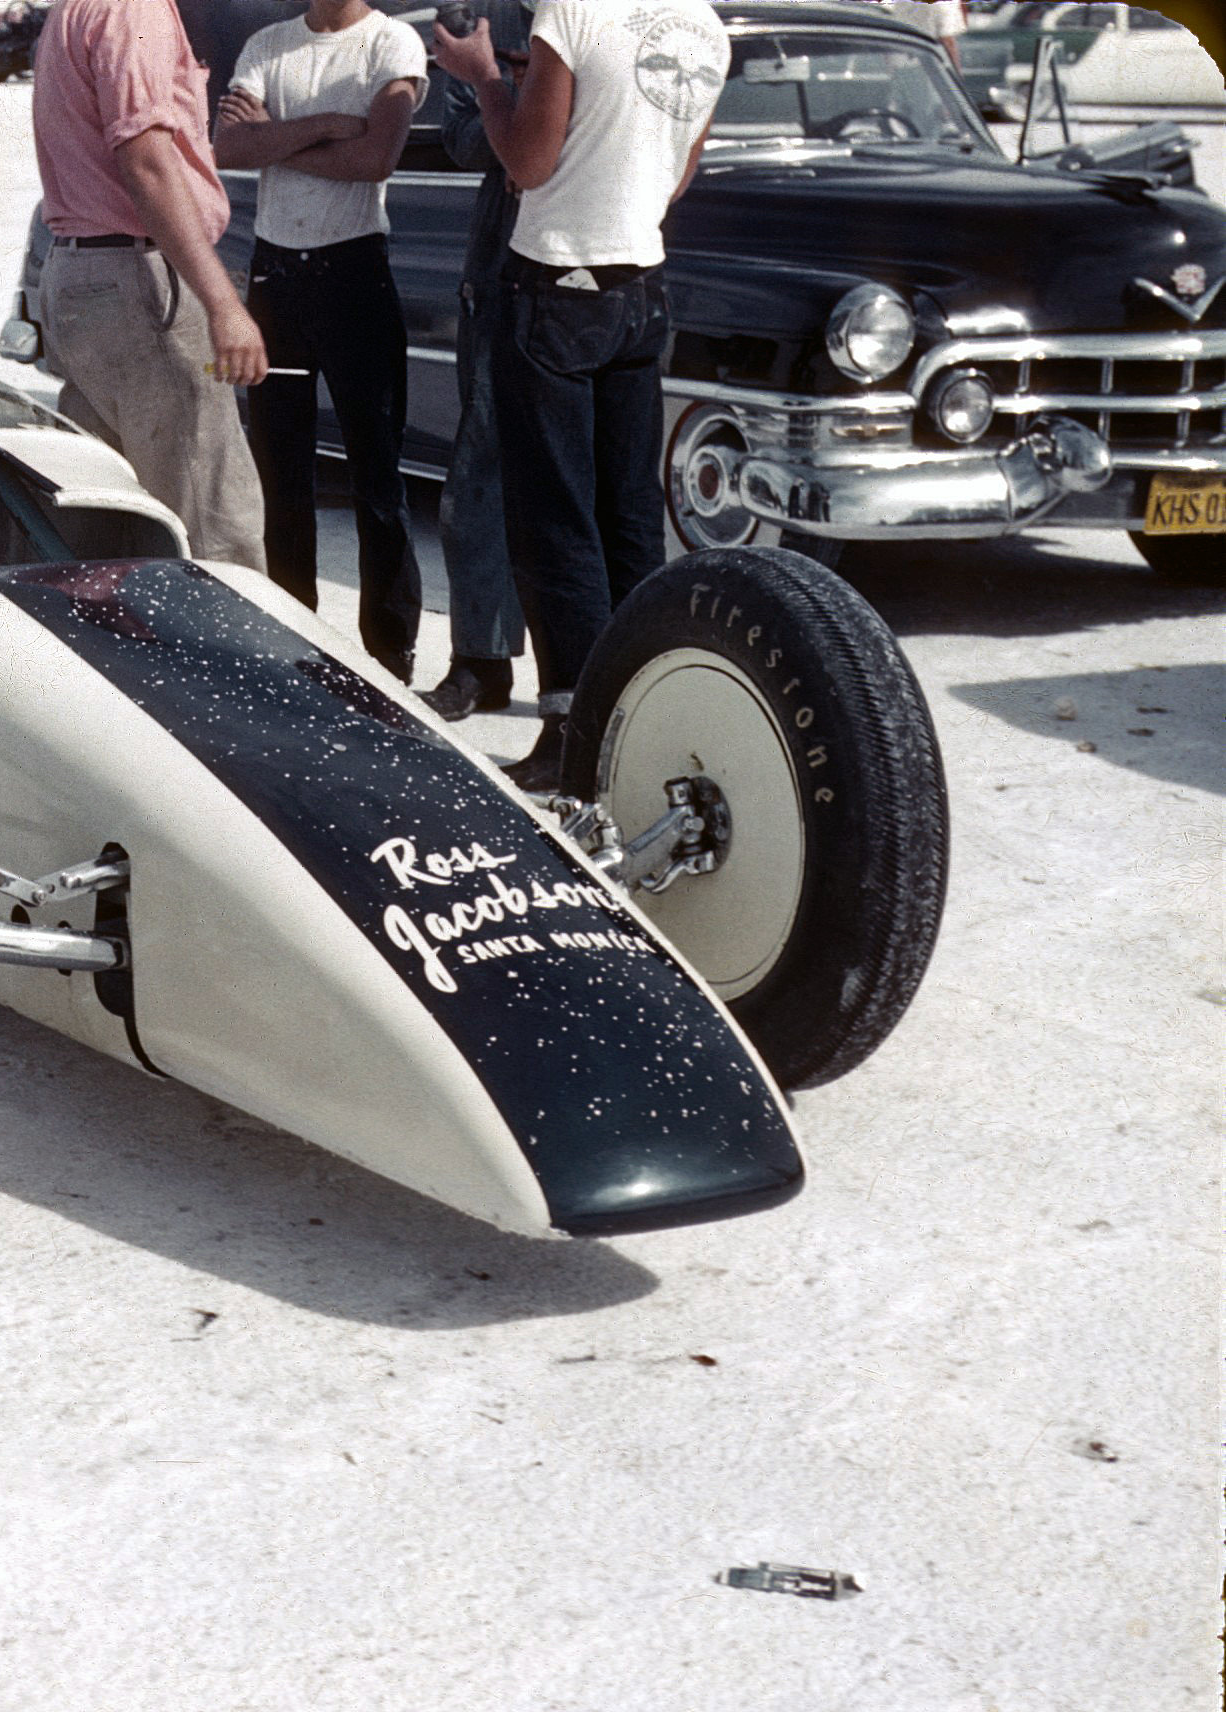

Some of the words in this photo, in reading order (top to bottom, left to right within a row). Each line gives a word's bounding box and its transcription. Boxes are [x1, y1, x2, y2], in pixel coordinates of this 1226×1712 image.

[1152, 491, 1200, 526] KHS
[690, 583, 834, 803] Firestone
[370, 837, 517, 889] Ross
[457, 935, 546, 964] SANTA
[550, 930, 656, 954] MONICA
